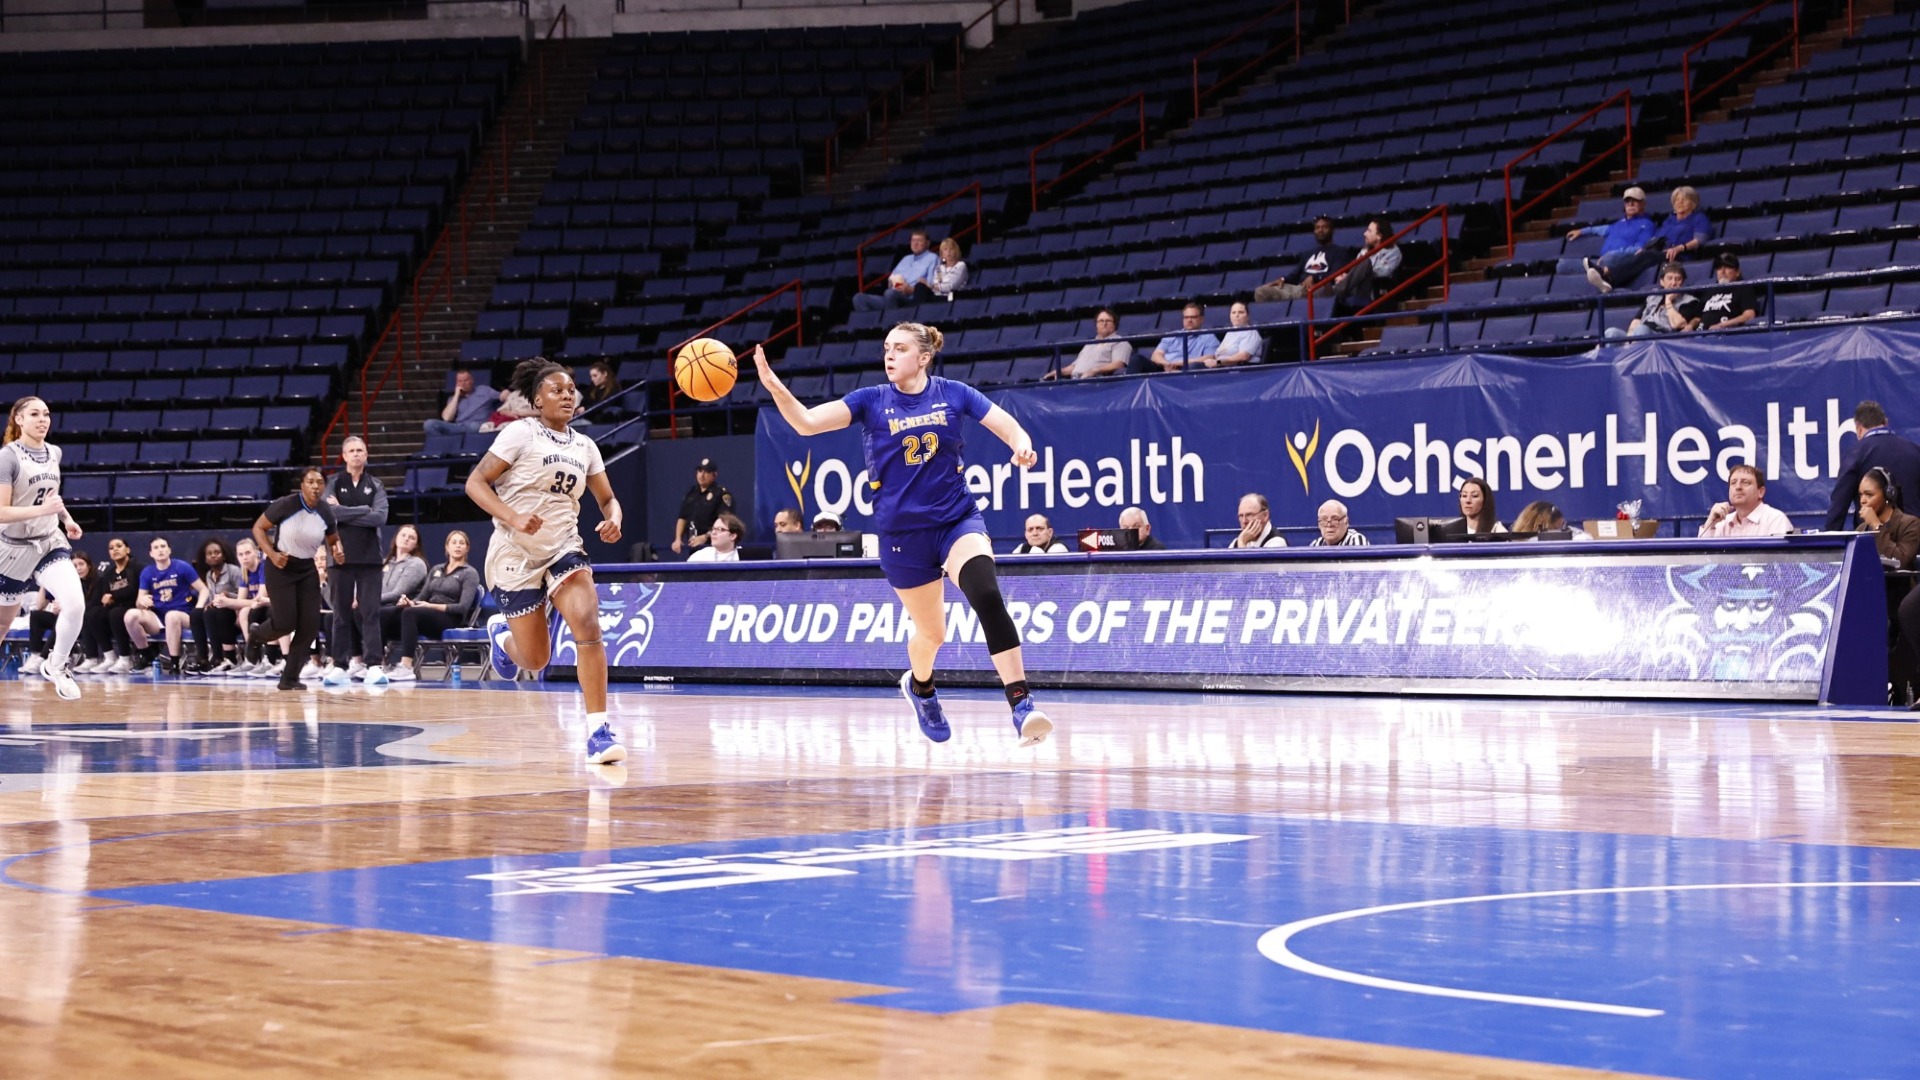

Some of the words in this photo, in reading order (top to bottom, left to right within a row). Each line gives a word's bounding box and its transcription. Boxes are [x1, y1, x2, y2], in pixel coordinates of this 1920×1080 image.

[888, 410, 948, 436] McNEESE
[902, 432, 938, 466] 23
[543, 453, 560, 467] NEW
[560, 454, 586, 474] ORLEANS
[28, 474, 41, 486] NEW
[550, 470, 577, 494] 33
[1097, 534, 1116, 547] POSS.
[707, 602, 839, 643] PROUD
[1066, 600, 1131, 643] OF
[1142, 599, 1234, 643] THE
